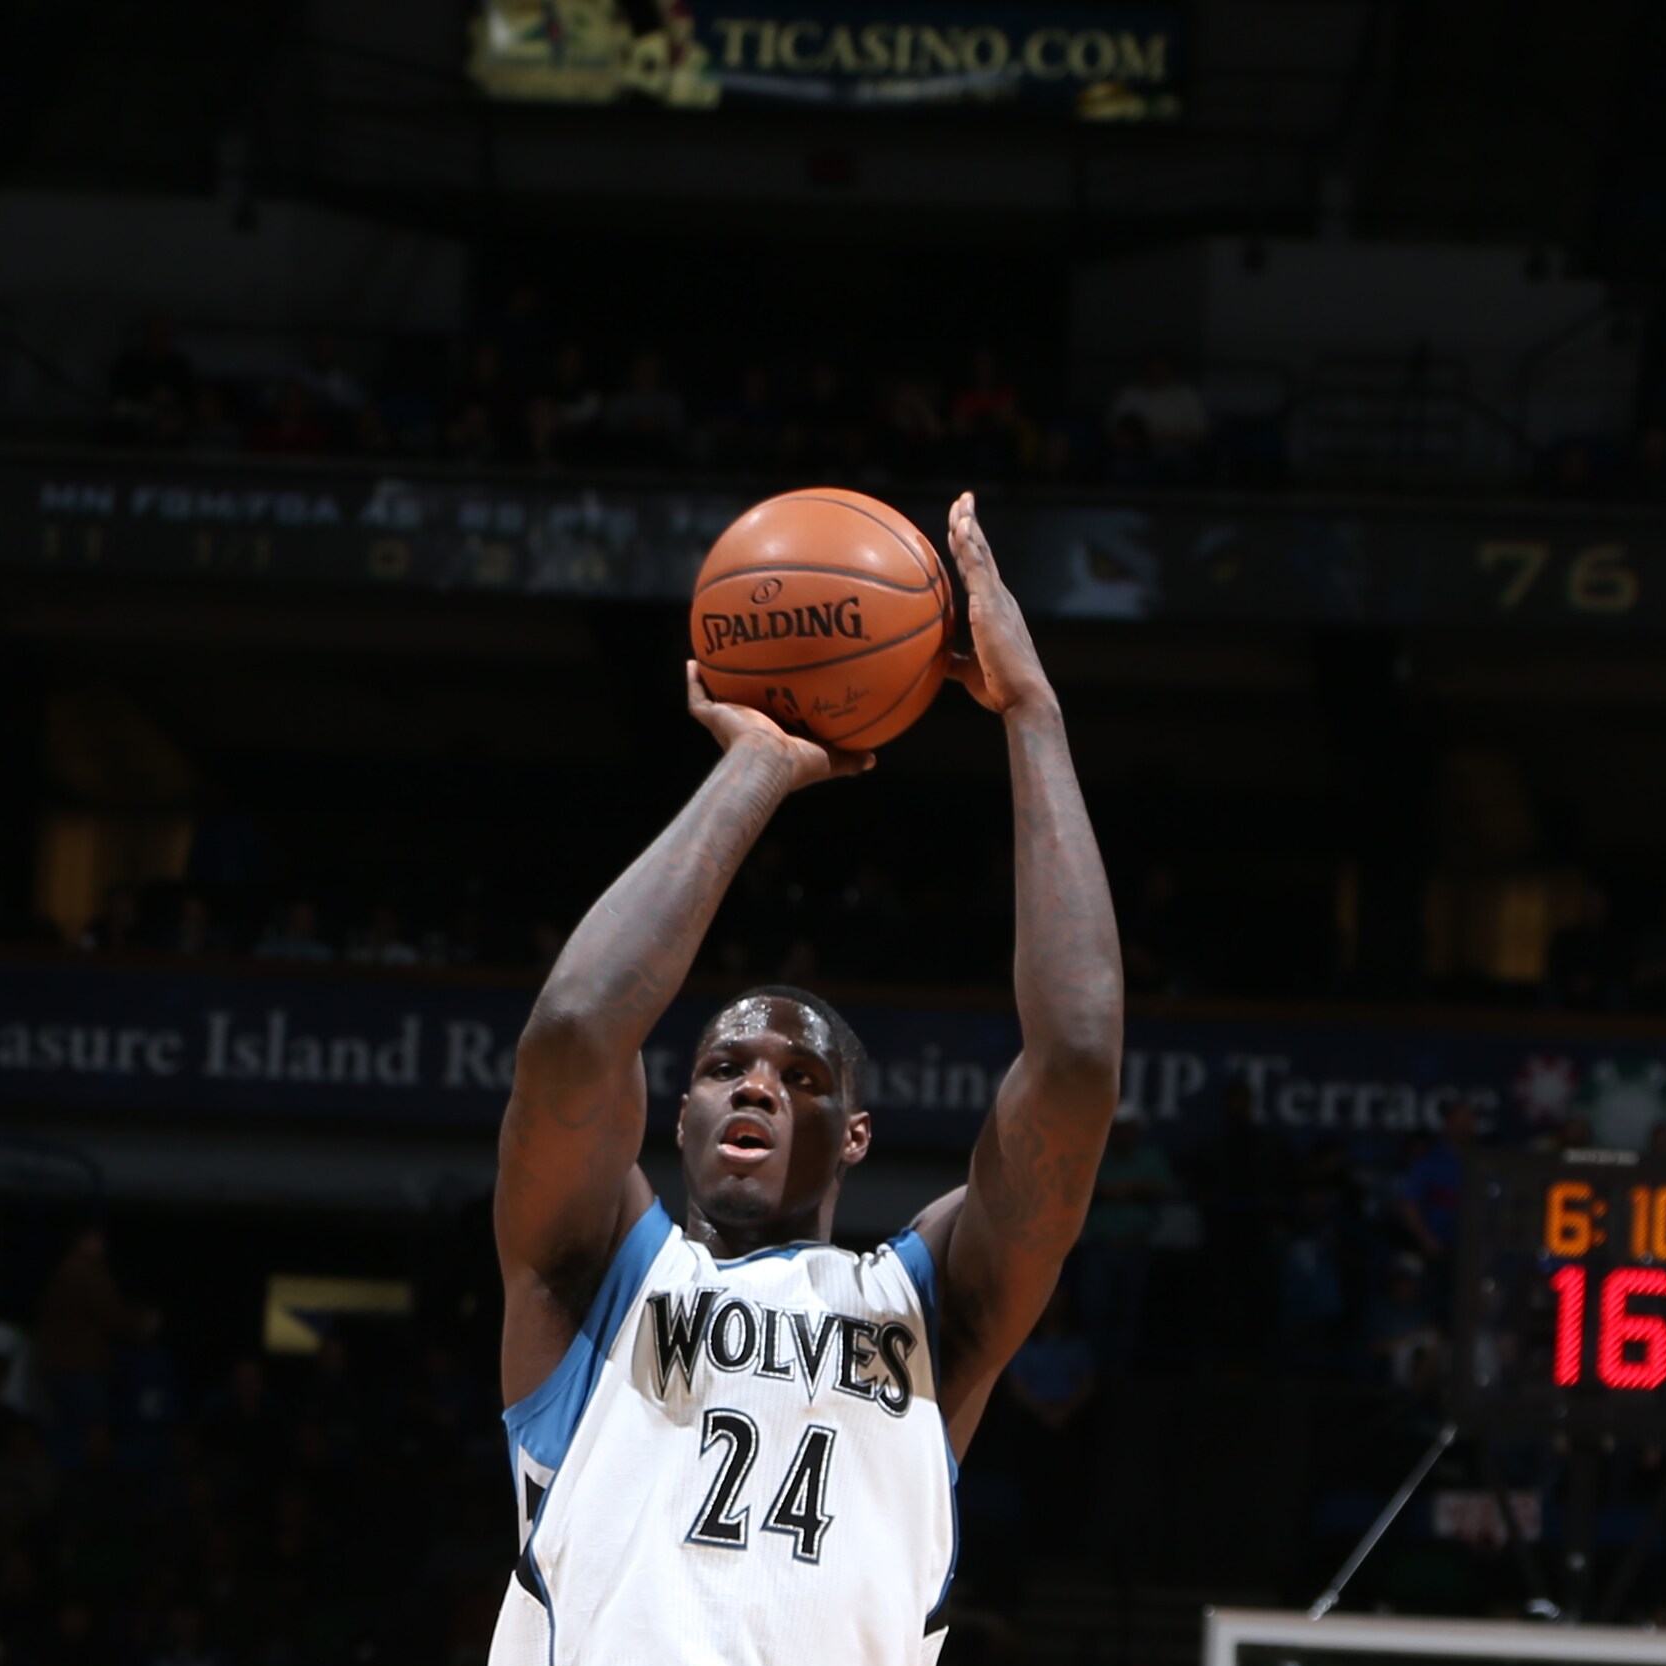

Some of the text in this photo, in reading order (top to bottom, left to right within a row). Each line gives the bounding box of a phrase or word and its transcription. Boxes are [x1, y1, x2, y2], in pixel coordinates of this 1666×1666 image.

[713, 17, 1169, 84] TICASINO.COM
[1477, 540, 1641, 614] 76
[701, 596, 864, 655] SPALDING
[201, 1008, 423, 1088] Island
[1223, 1052, 1499, 1136] Terrace
[647, 1286, 917, 1418] WOLVES
[684, 1407, 837, 1566] 24
